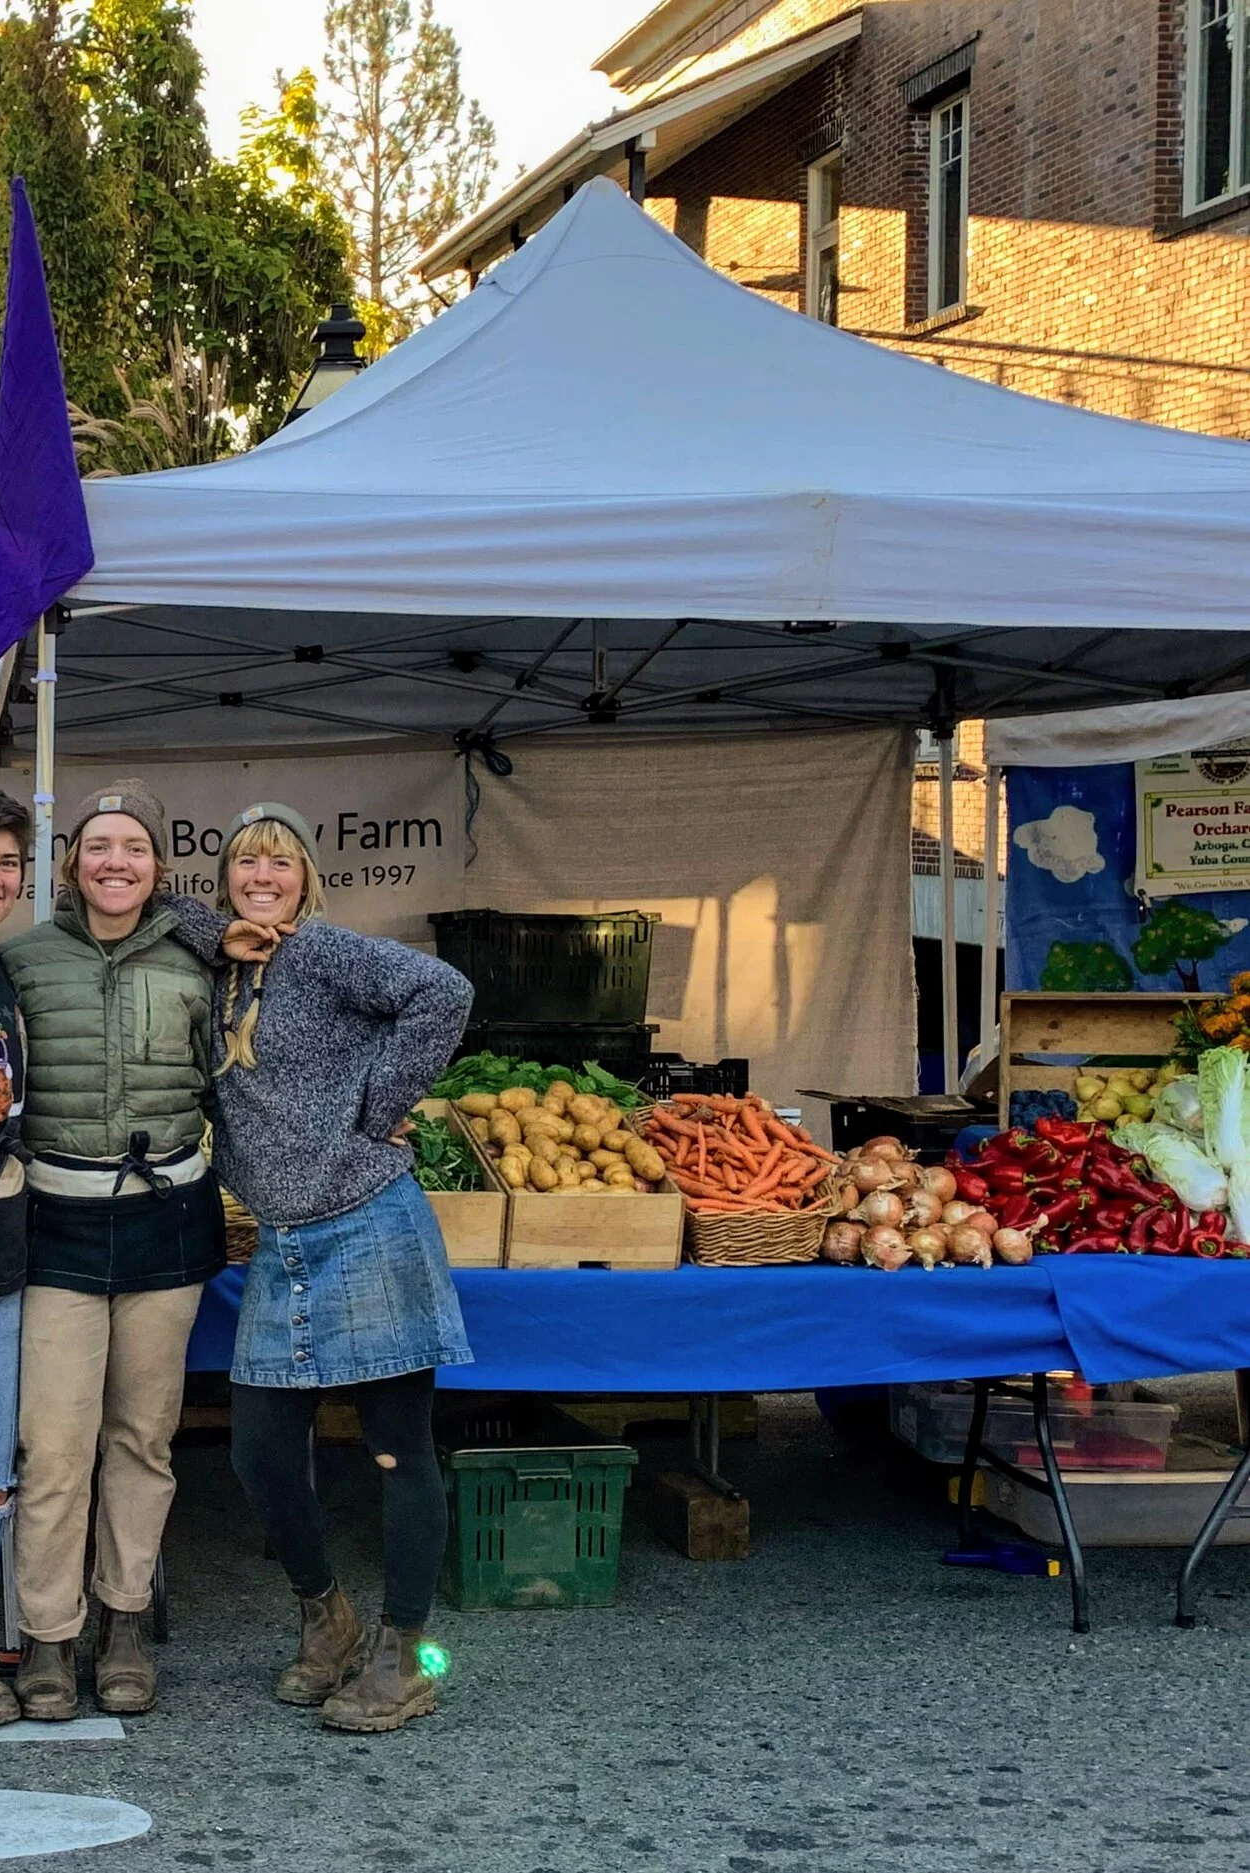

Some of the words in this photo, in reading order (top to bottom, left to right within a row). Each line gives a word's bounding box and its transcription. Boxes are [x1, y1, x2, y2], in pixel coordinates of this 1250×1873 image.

[1165, 803, 1229, 818] Pearson
[338, 812, 442, 851] Farm
[1193, 822, 1250, 836] Orchar
[1190, 855, 1219, 866] Yuba
[361, 865, 416, 886] 1997
